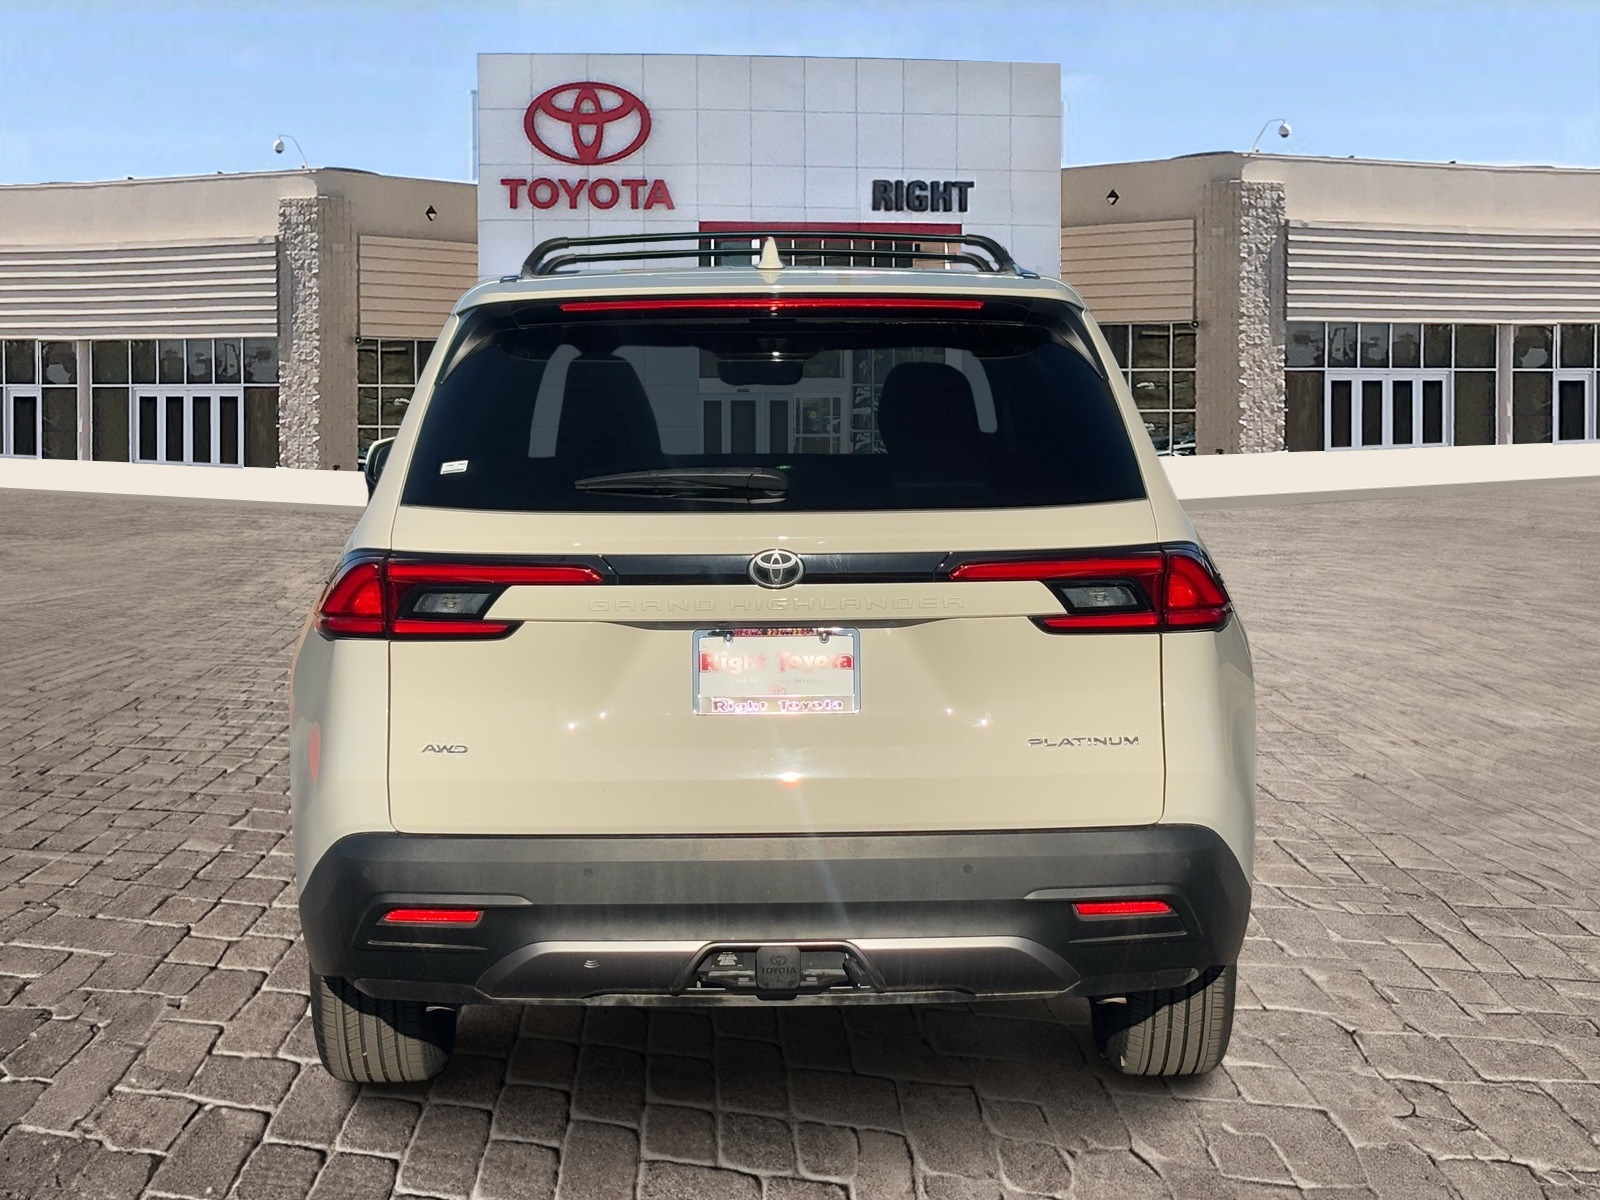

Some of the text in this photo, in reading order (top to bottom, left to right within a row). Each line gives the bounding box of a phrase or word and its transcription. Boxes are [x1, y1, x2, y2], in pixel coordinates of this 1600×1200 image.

[500, 178, 675, 210] TOYOTA
[872, 179, 975, 213] RIGHT
[588, 596, 965, 612] GRAND HIGHLANDER
[712, 699, 844, 713] Right Toyota
[421, 744, 469, 753] AWD
[1027, 736, 1139, 747] PLATINUM
[761, 966, 797, 974] TOYOTA
